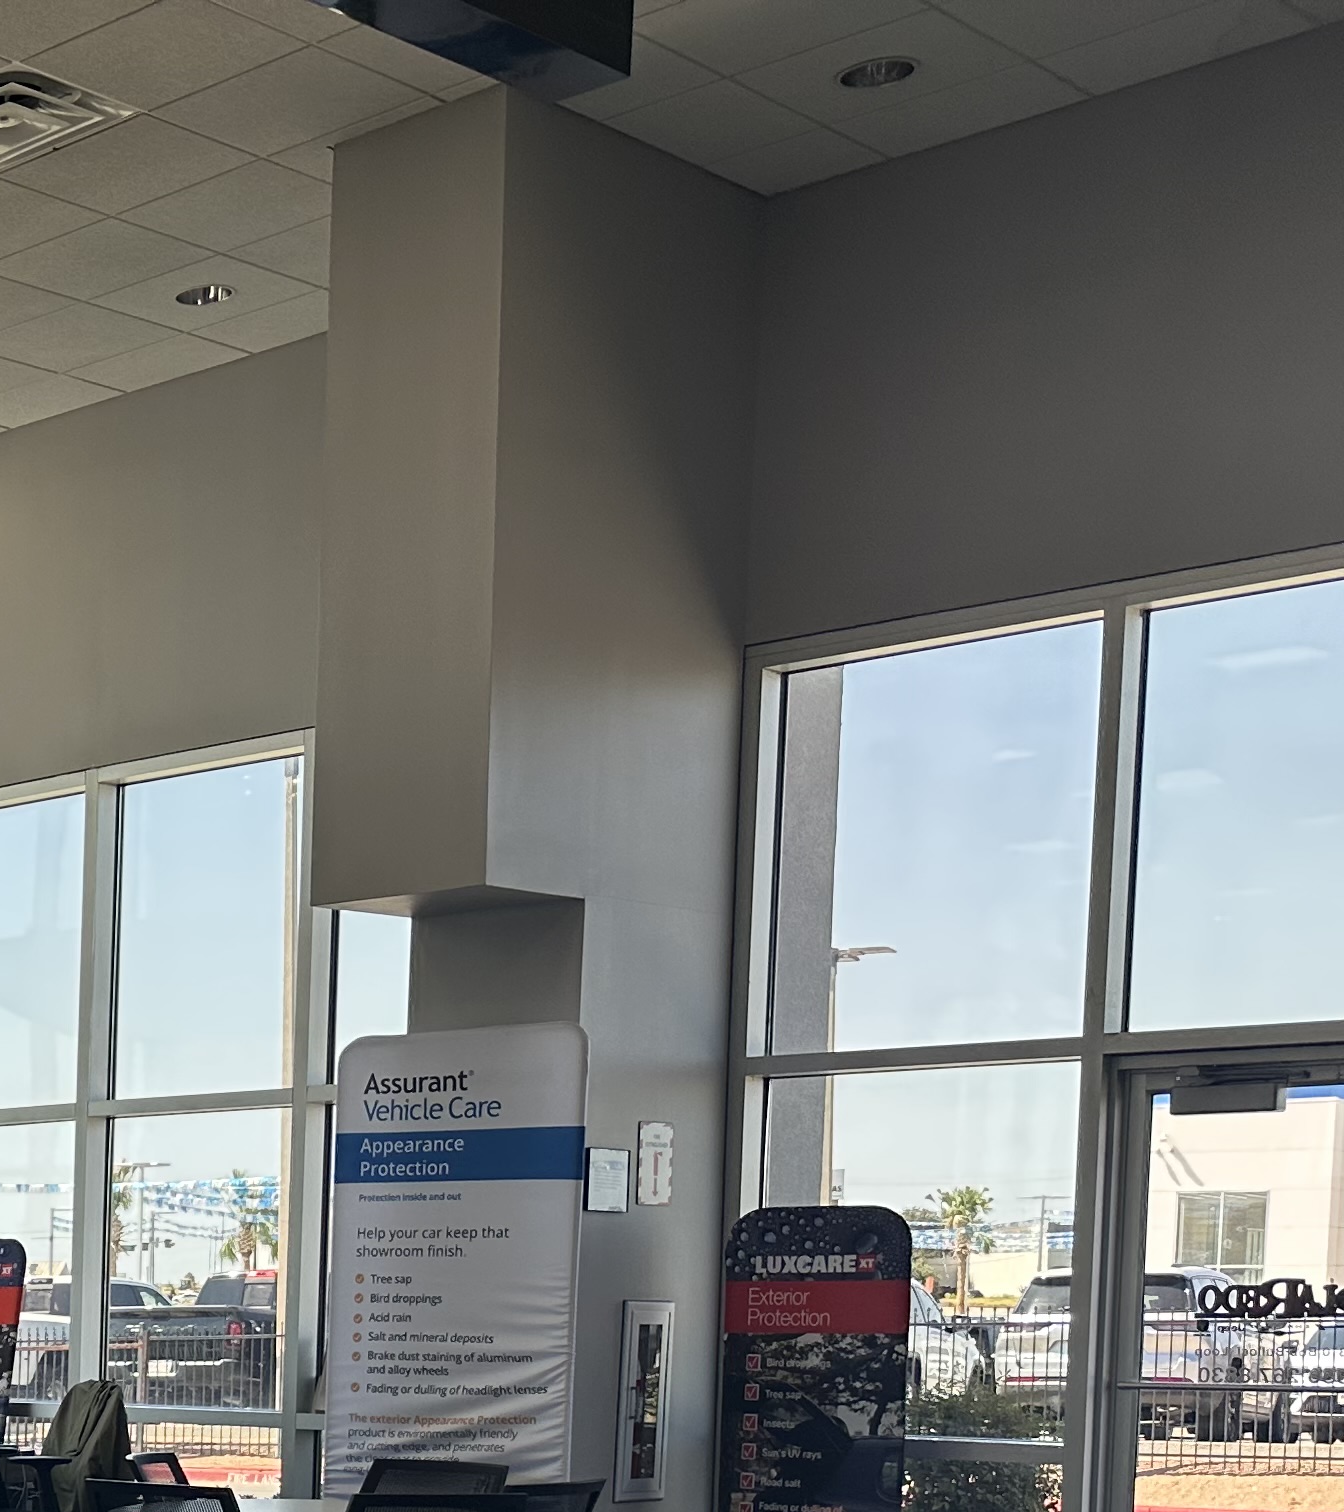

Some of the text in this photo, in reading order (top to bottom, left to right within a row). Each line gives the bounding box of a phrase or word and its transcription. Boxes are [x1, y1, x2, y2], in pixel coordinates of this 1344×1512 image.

[363, 1070, 469, 1095] Assurant
[363, 1096, 502, 1122] Vehicle Care
[359, 1138, 465, 1158] Appearance
[359, 1159, 450, 1177] Protection
[358, 1193, 401, 1203] Protection
[428, 1192, 445, 1202] and
[446, 1192, 462, 1202] out
[357, 1226, 510, 1243] Help your car keep that
[356, 1244, 466, 1258] showroom finish.
[754, 1254, 874, 1274] LUXCARE XT
[370, 1273, 412, 1286] Tree sap
[370, 1293, 443, 1307] Bird droppings
[748, 1287, 810, 1306] Exterior
[369, 1312, 412, 1323] Acid rain
[747, 1308, 830, 1327] Protection
[368, 1331, 495, 1346] Salt and mineral deposits
[367, 1350, 533, 1365] Brake dust staining of aluminum
[766, 1357, 785, 1368] Bird
[367, 1364, 450, 1377] and alloy wheels
[366, 1384, 548, 1399] Fading or dulling of headlight lenses
[765, 1389, 802, 1401] Tree sap
[348, 1412, 537, 1428] The exterior Appearance Protection
[762, 1419, 796, 1429] Insects
[348, 1428, 519, 1442] product is environmentally friendly
[347, 1441, 366, 1451] and
[431, 1442, 451, 1452] and
[452, 1442, 505, 1455] penetrates
[761, 1448, 822, 1460] Sun's UV rays
[227, 1472, 250, 1485] FIRE
[784, 1478, 801, 1489] salt
[789, 1503, 800, 1512] or
